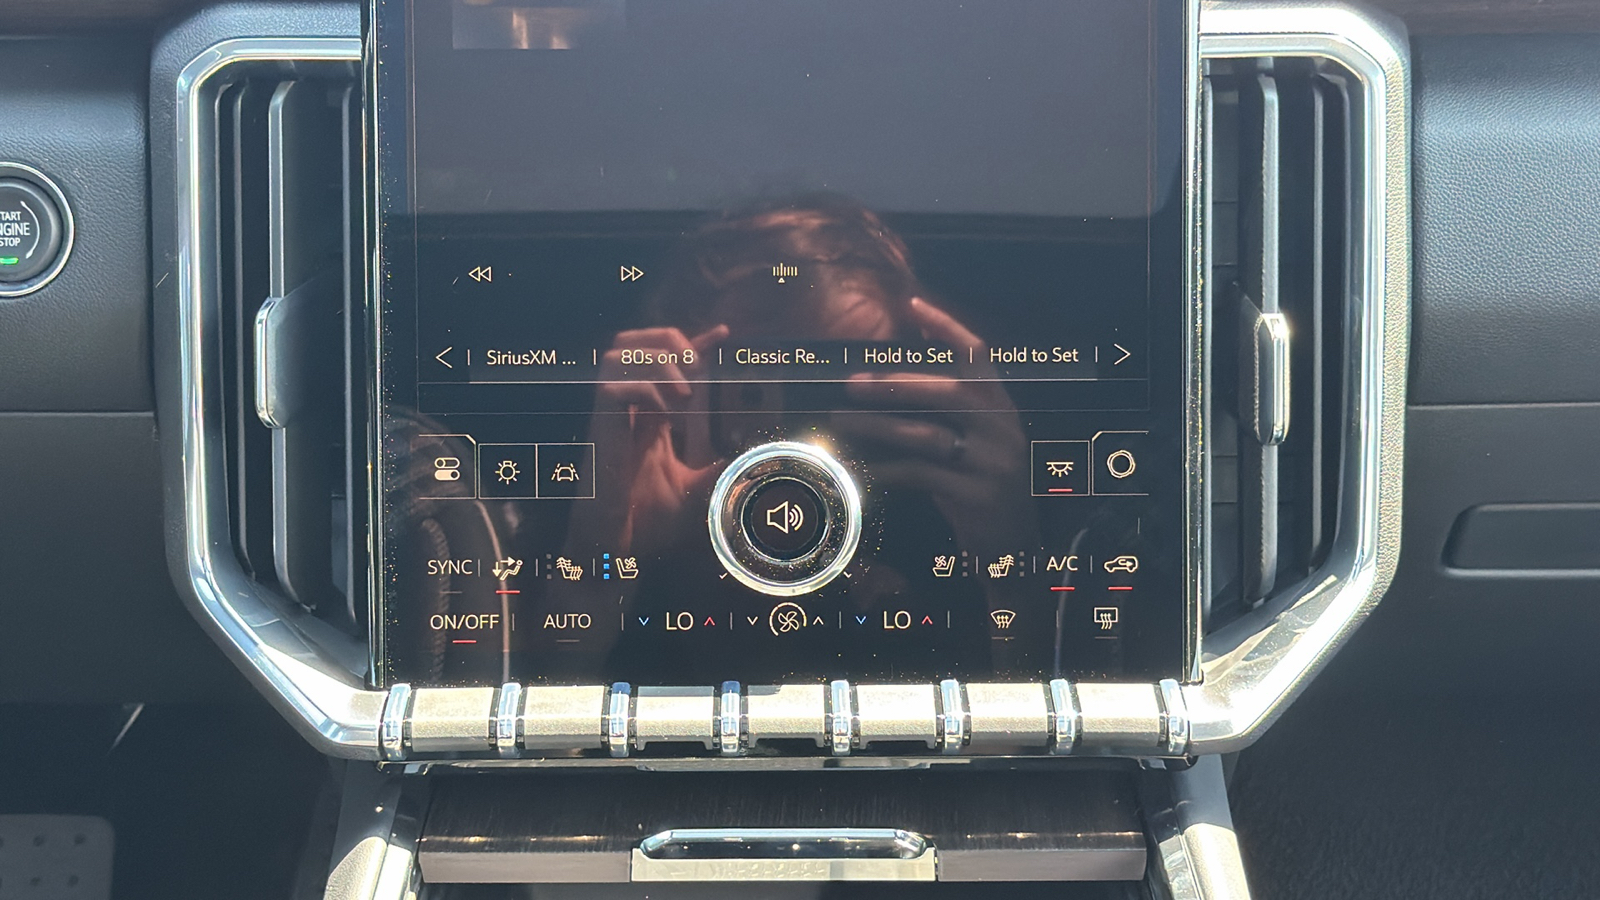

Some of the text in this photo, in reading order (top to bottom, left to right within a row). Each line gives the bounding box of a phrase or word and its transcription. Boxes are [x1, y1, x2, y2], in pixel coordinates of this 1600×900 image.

[0, 211, 22, 221] TART
[0, 222, 31, 236] GINE
[0, 237, 21, 247] STOP
[486, 349, 557, 365] SiriusXM
[621, 349, 694, 365] 80s on 8
[735, 348, 790, 364] Classic
[864, 347, 954, 364] Hold to Set
[989, 346, 1079, 363] Hold to Set
[427, 559, 473, 575] SYNC
[1046, 555, 1078, 572] A/C
[430, 613, 500, 630] ON/OFF
[543, 613, 592, 629] AUTO
[665, 611, 694, 631] LO
[883, 610, 912, 630] LO
